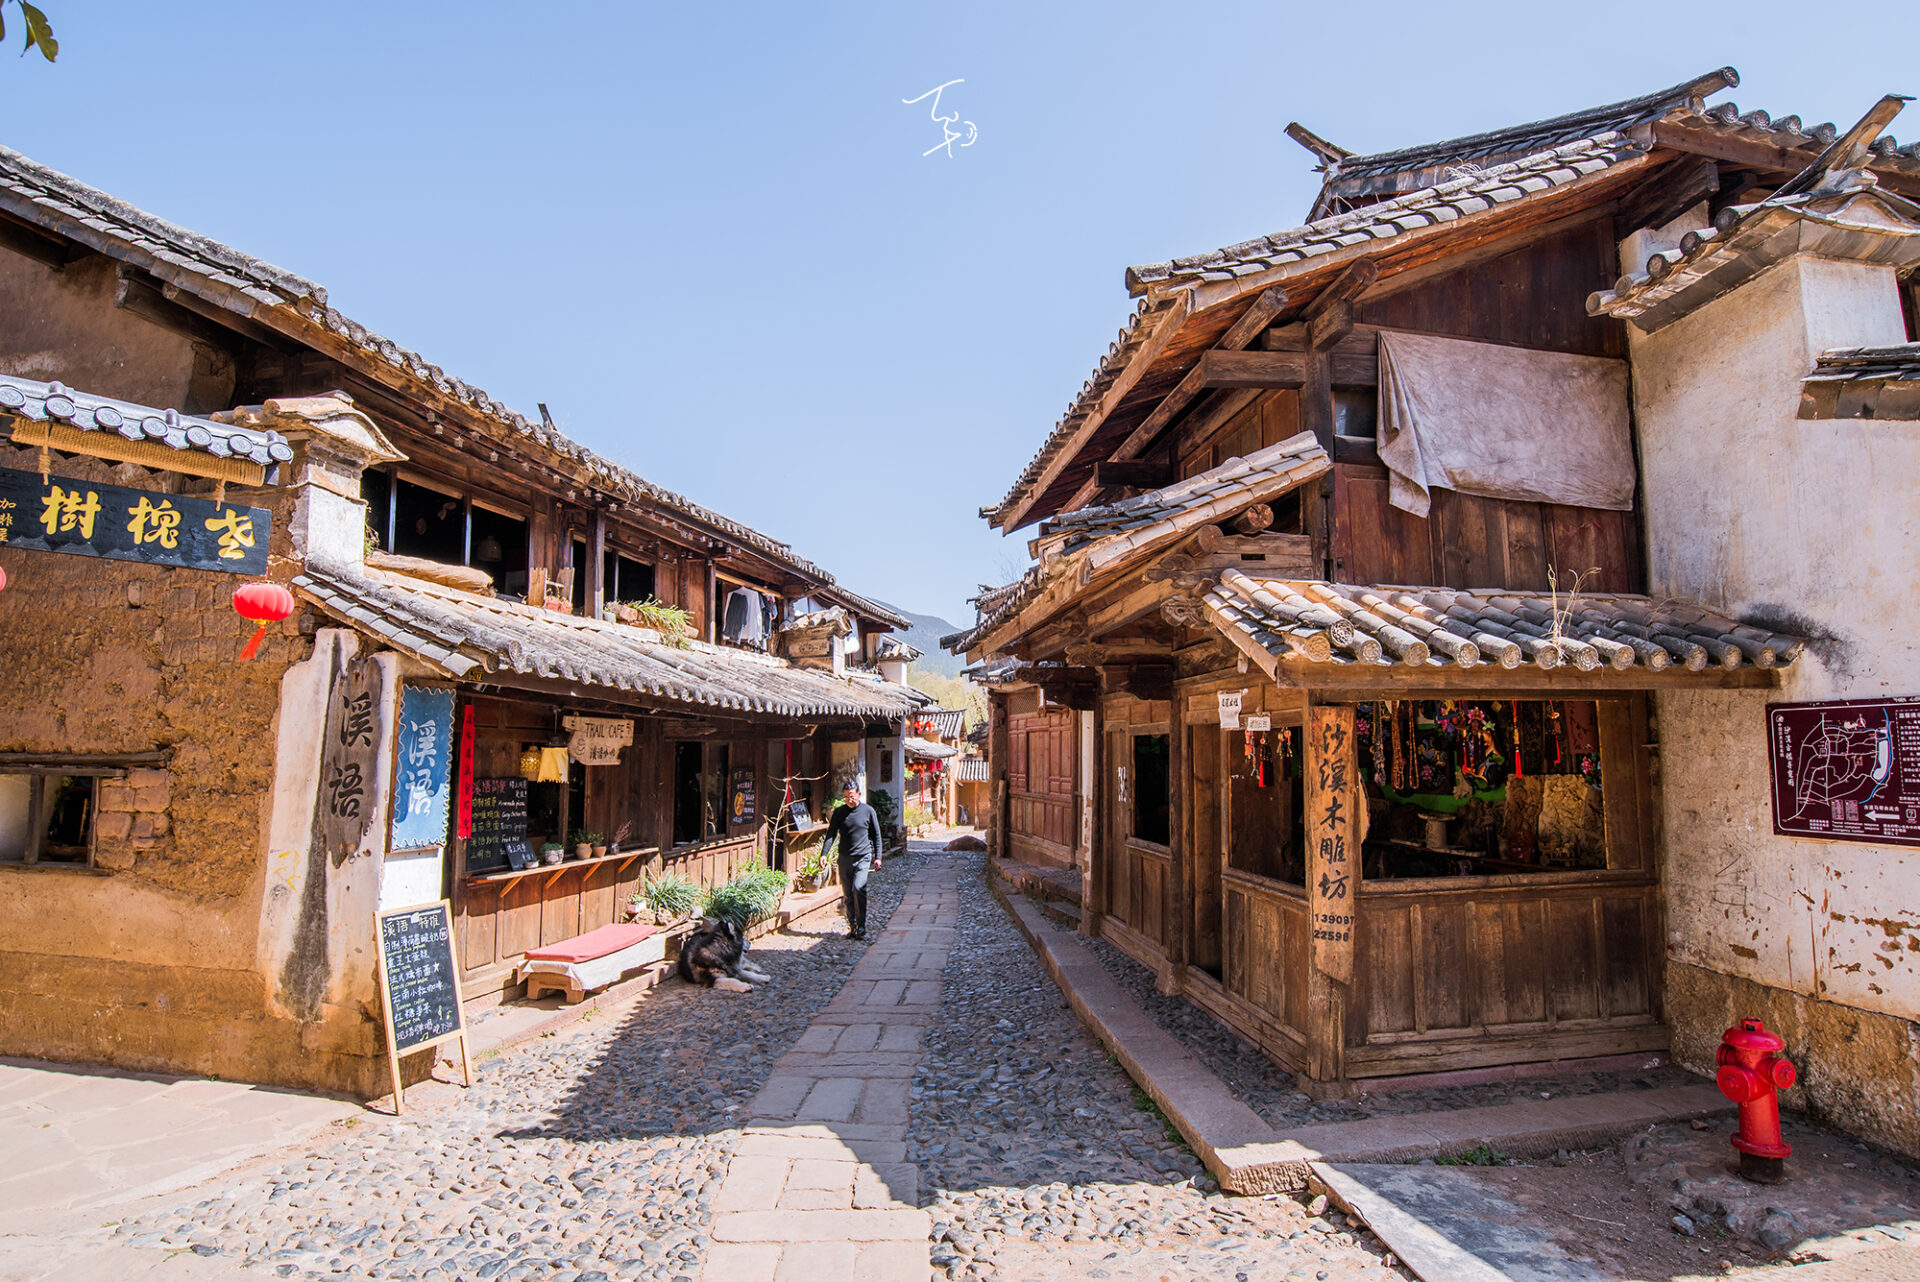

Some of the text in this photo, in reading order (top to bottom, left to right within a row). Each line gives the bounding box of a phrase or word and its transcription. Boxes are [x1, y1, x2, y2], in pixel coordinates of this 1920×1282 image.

[328, 691, 374, 822] 溪语
[405, 720, 437, 819] 溪语
[585, 723, 605, 738] TRAIL
[1318, 722, 1350, 902] 沙溪木雕坊
[1313, 929, 1349, 942] 22598
